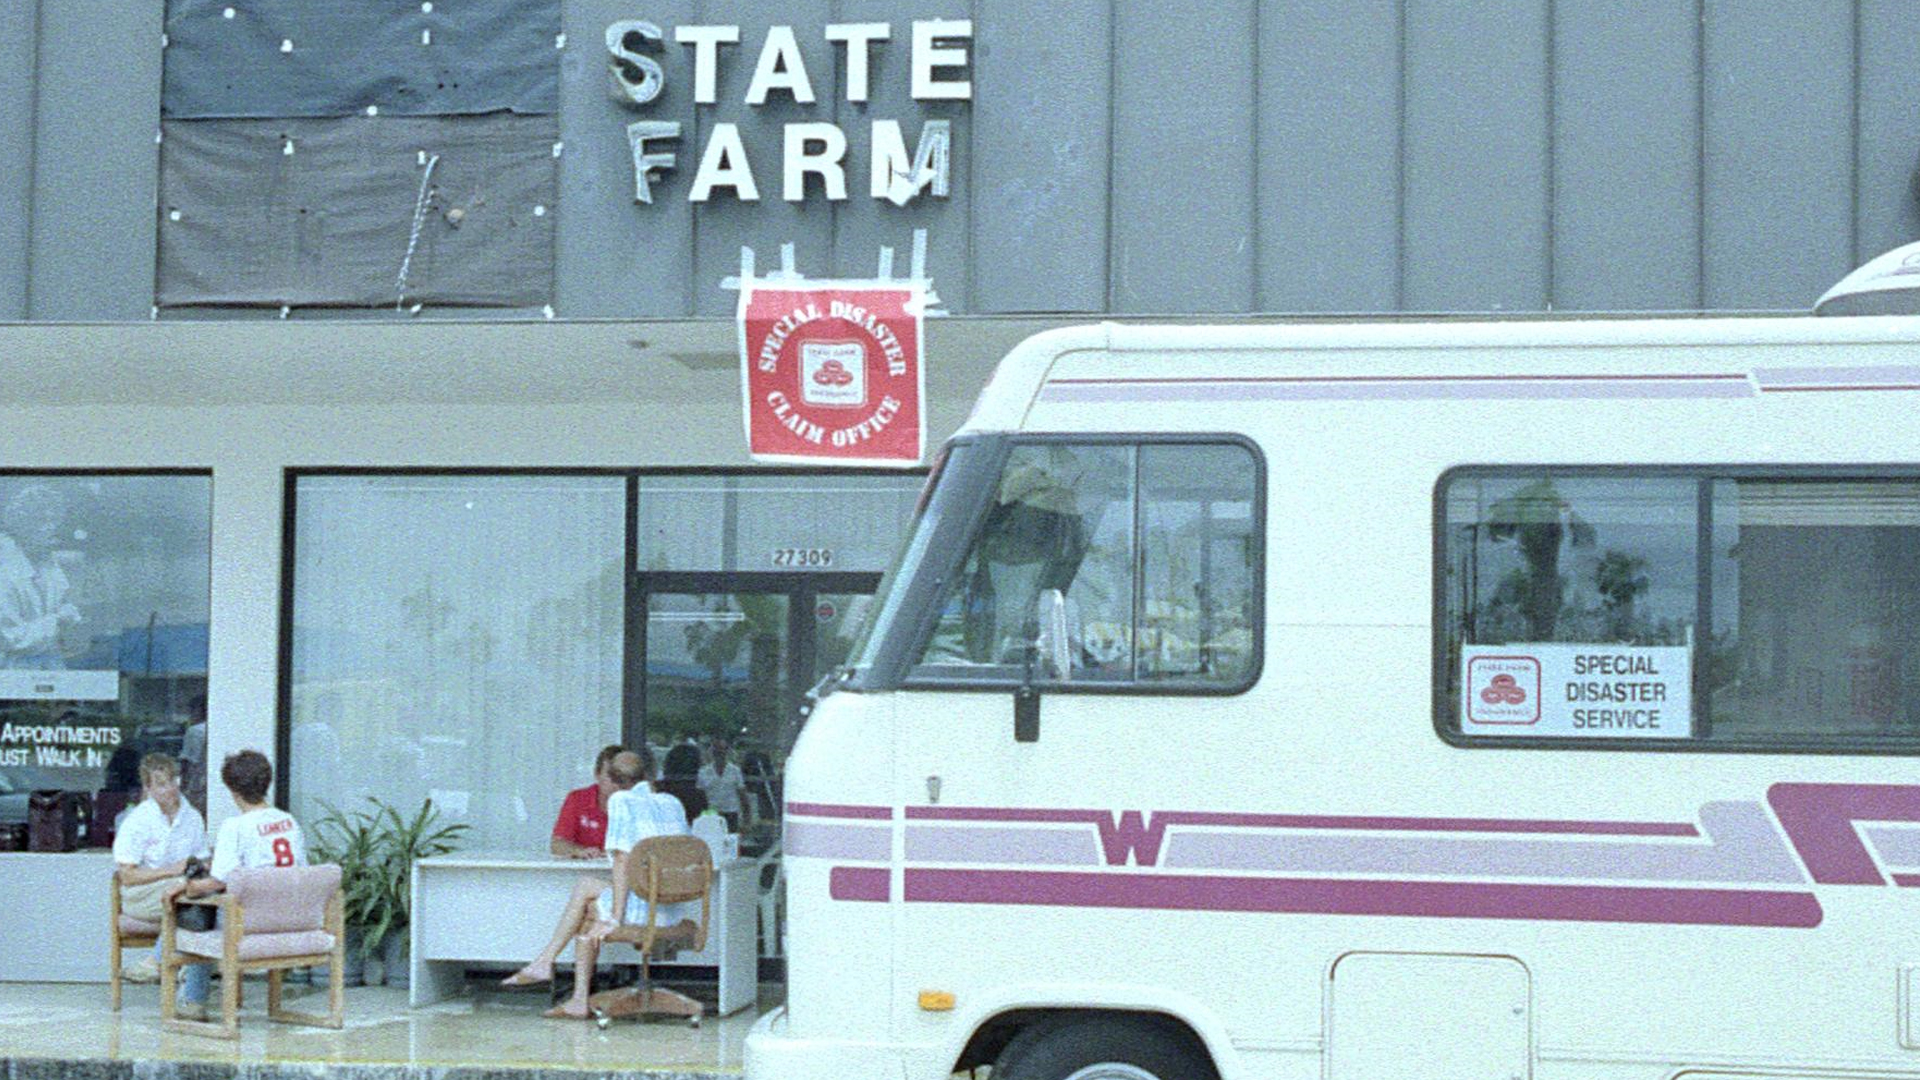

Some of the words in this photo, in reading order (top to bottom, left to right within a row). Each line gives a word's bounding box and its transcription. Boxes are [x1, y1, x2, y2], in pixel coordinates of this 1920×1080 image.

[605, 19, 973, 104] STATE
[627, 119, 951, 206] FARM
[758, 303, 823, 373] SPECIAL
[830, 300, 907, 377] DISASTER
[767, 391, 825, 445] CLAIM
[831, 395, 901, 447] OFFICE
[774, 549, 831, 566] 27309
[1574, 655, 1659, 675] SPECIAL
[1566, 683, 1666, 703] DISASTER
[1573, 709, 1660, 729] SERVICE
[36, 746, 81, 767] WALK
[272, 838, 294, 868] 8
